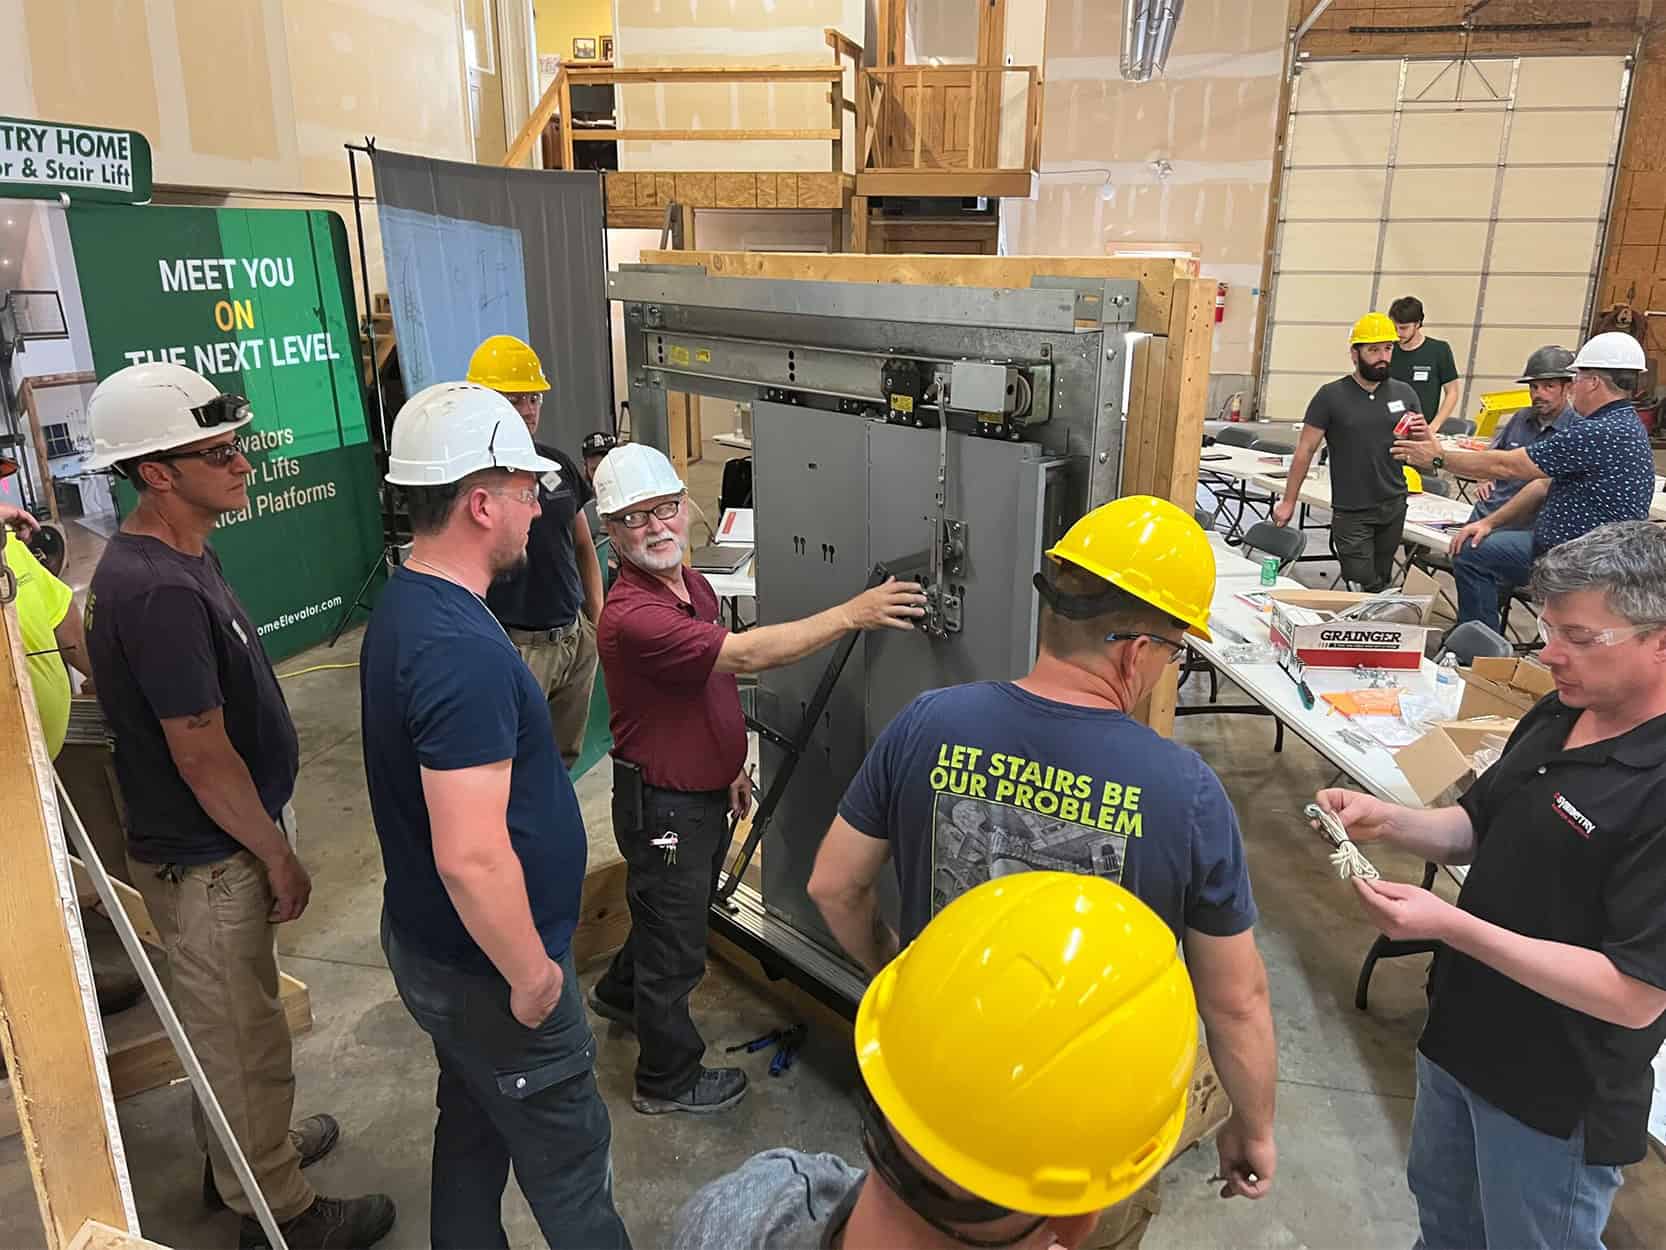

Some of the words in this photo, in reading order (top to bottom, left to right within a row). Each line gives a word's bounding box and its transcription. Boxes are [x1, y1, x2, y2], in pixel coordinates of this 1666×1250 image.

[0, 126, 48, 153] TRY
[56, 129, 129, 160] HOME
[0, 161, 13, 177] r
[22, 157, 38, 178] &
[46, 159, 94, 182] Stair
[101, 163, 130, 186] Lift
[159, 258, 236, 292] MEET
[245, 257, 295, 289] YOU
[214, 300, 255, 332] ON
[193, 339, 264, 376] NEXT
[269, 333, 340, 367] LEVEL
[238, 427, 294, 454] vators
[262, 456, 300, 482] Lifts
[215, 503, 252, 529] ical
[256, 480, 336, 518] Platforms
[1320, 630, 1401, 643] GRAINGER
[937, 743, 984, 771] LET
[988, 752, 1094, 799] STAIRS
[1101, 781, 1142, 811] BE
[929, 766, 987, 798] OUR
[995, 778, 1144, 838] PROBLEM
